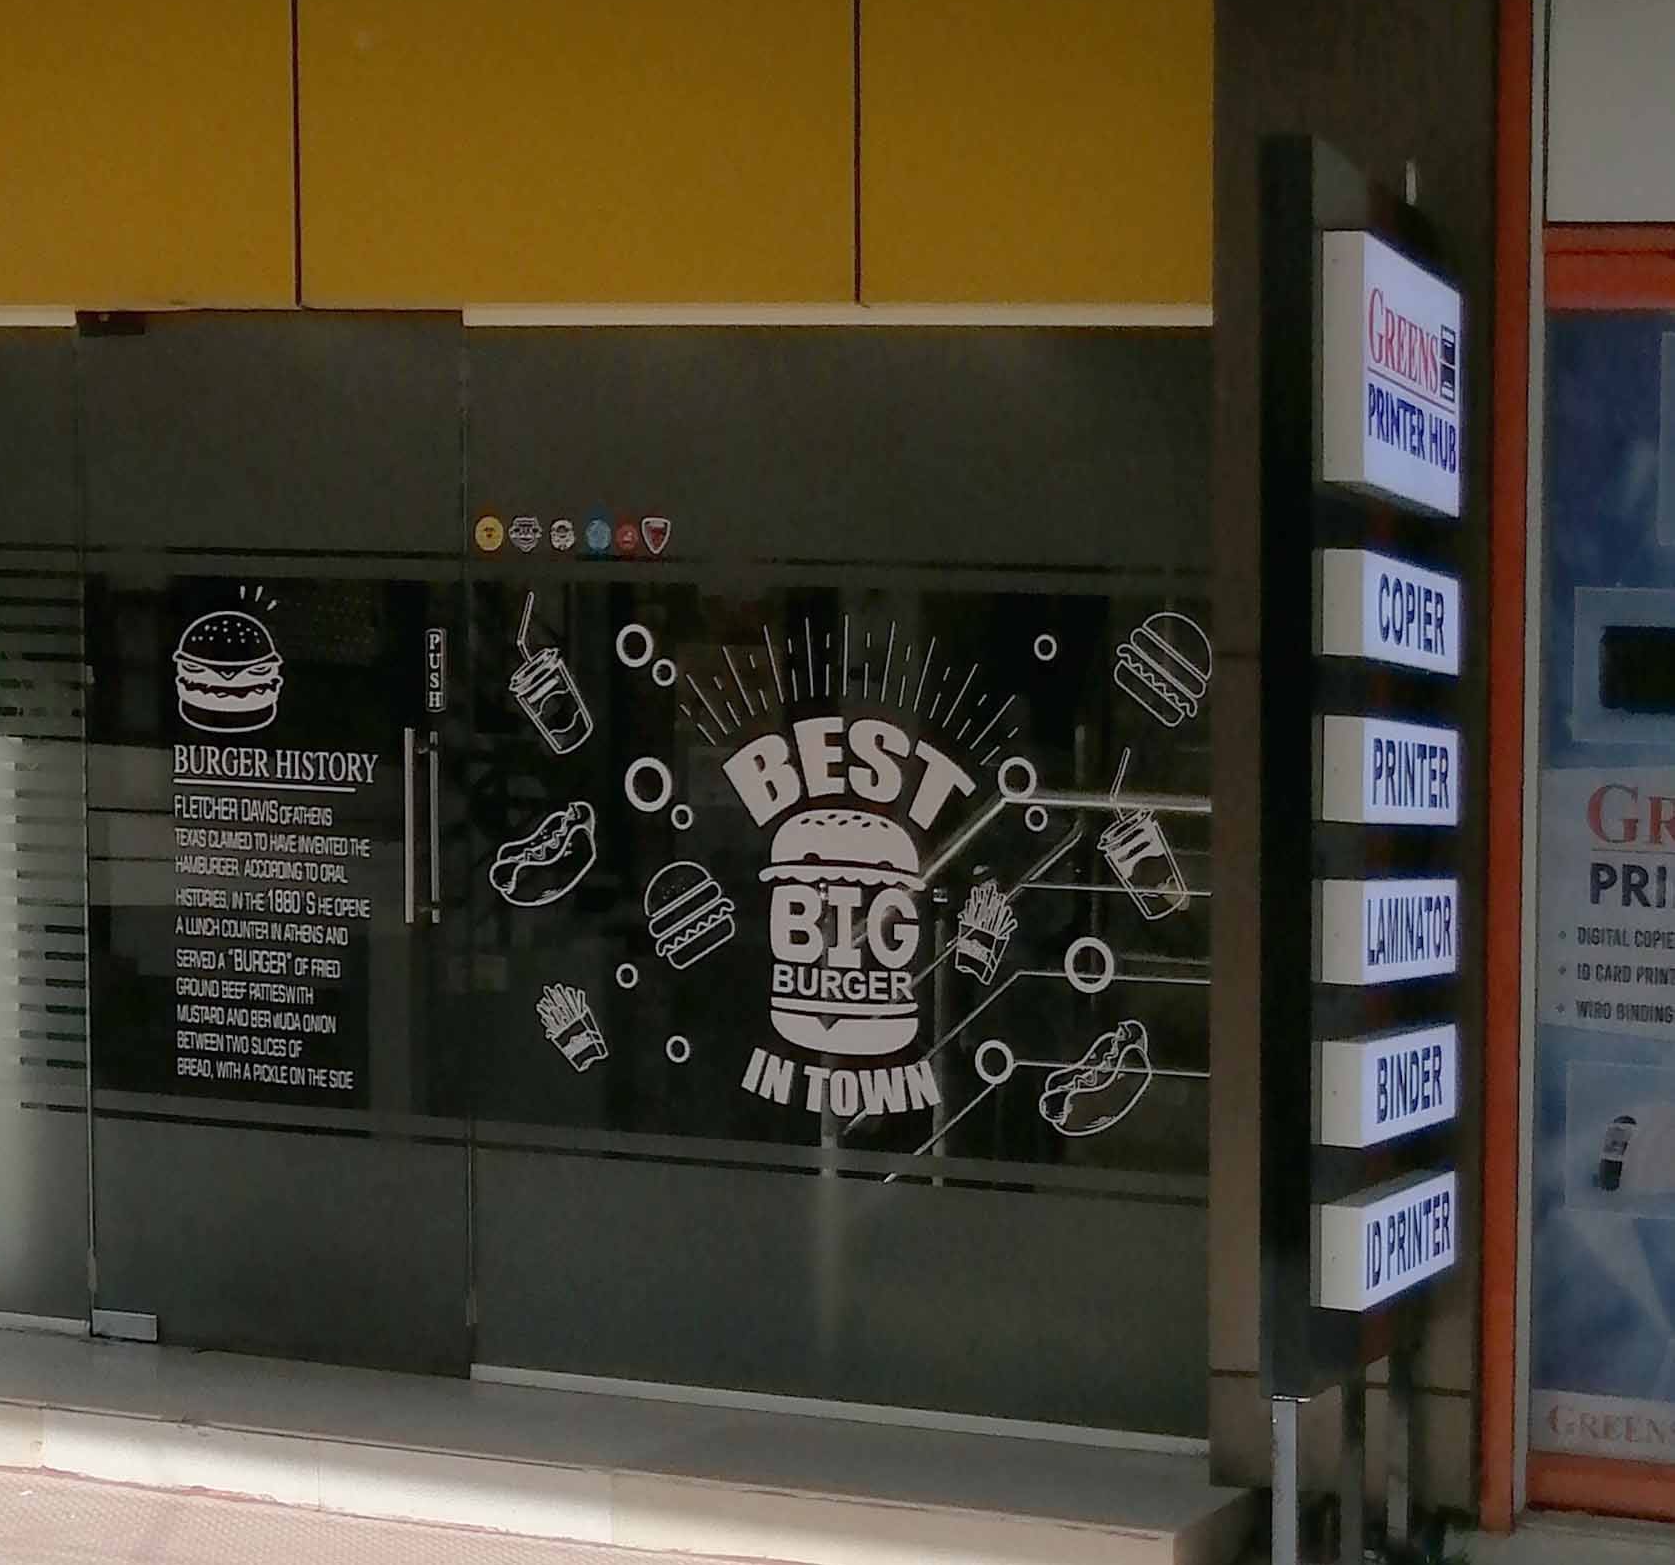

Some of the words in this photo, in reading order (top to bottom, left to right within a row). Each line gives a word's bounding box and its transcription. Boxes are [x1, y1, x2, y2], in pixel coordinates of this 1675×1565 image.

[1367, 287, 1439, 396] GREENS
[1368, 383, 1425, 461] PRINTER
[1429, 424, 1456, 474] HUB
[1378, 572, 1445, 656] COPIER
[429, 634, 441, 708] PUSH
[173, 744, 270, 778] BURGER
[276, 749, 378, 784] HISTORY
[723, 716, 977, 831] BEST
[1373, 736, 1450, 811] PRINTER
[174, 795, 238, 820] FLETCHER
[241, 798, 278, 824] DAVIS
[175, 827, 207, 848] TEXAS
[208, 830, 252, 851] CLAIMED
[254, 832, 267, 852] TO
[269, 834, 297, 853] HAVE
[298, 835, 348, 856] INVENTED
[350, 838, 371, 858] THE
[244, 859, 302, 882] ACCORDING
[304, 862, 318, 882] TO
[320, 865, 349, 884] ORAL
[231, 892, 242, 910] IN
[245, 892, 265, 912] THE
[318, 898, 333, 916] HE
[176, 916, 184, 934] A
[185, 917, 220, 936] LUNCH
[222, 919, 269, 940] COUNTER
[271, 922, 283, 941] IN
[284, 924, 324, 945] ATHENS
[325, 926, 349, 946] AND
[770, 884, 920, 969] BIG
[1366, 895, 1453, 969] LAMINATOR
[1577, 927, 1630, 947] DIGITAL
[176, 949, 216, 970] SERVED
[218, 952, 226, 970] A
[294, 958, 309, 976] OF
[311, 959, 341, 979] FRIED
[1577, 963, 1590, 980] ID
[1596, 964, 1631, 983] CARD
[176, 977, 219, 998] GROUND
[222, 980, 247, 1000] BEEF
[773, 964, 915, 1001] BURGER
[177, 1004, 225, 1025] MUSTARD
[226, 1008, 248, 1027] AND
[303, 1014, 336, 1034] ONION
[1616, 1002, 1674, 1024] BINDING
[177, 1030, 224, 1052] BETWEEN
[225, 1034, 248, 1054] TWO
[251, 1037, 287, 1057] SLICES
[288, 1039, 303, 1058] OF
[177, 1057, 214, 1079] BREAD,
[216, 1061, 242, 1079] WITH
[243, 1062, 251, 1081] A
[253, 1063, 288, 1084] PICKLE
[290, 1066, 305, 1086] ON
[307, 1068, 326, 1087] THE
[329, 1069, 354, 1089] SIDE
[741, 1047, 795, 1105] IN
[804, 1059, 942, 1117] TOWN
[1377, 1043, 1443, 1125] BINDER
[1366, 1220, 1382, 1291] ID
[1386, 1190, 1451, 1281] PRINTER
